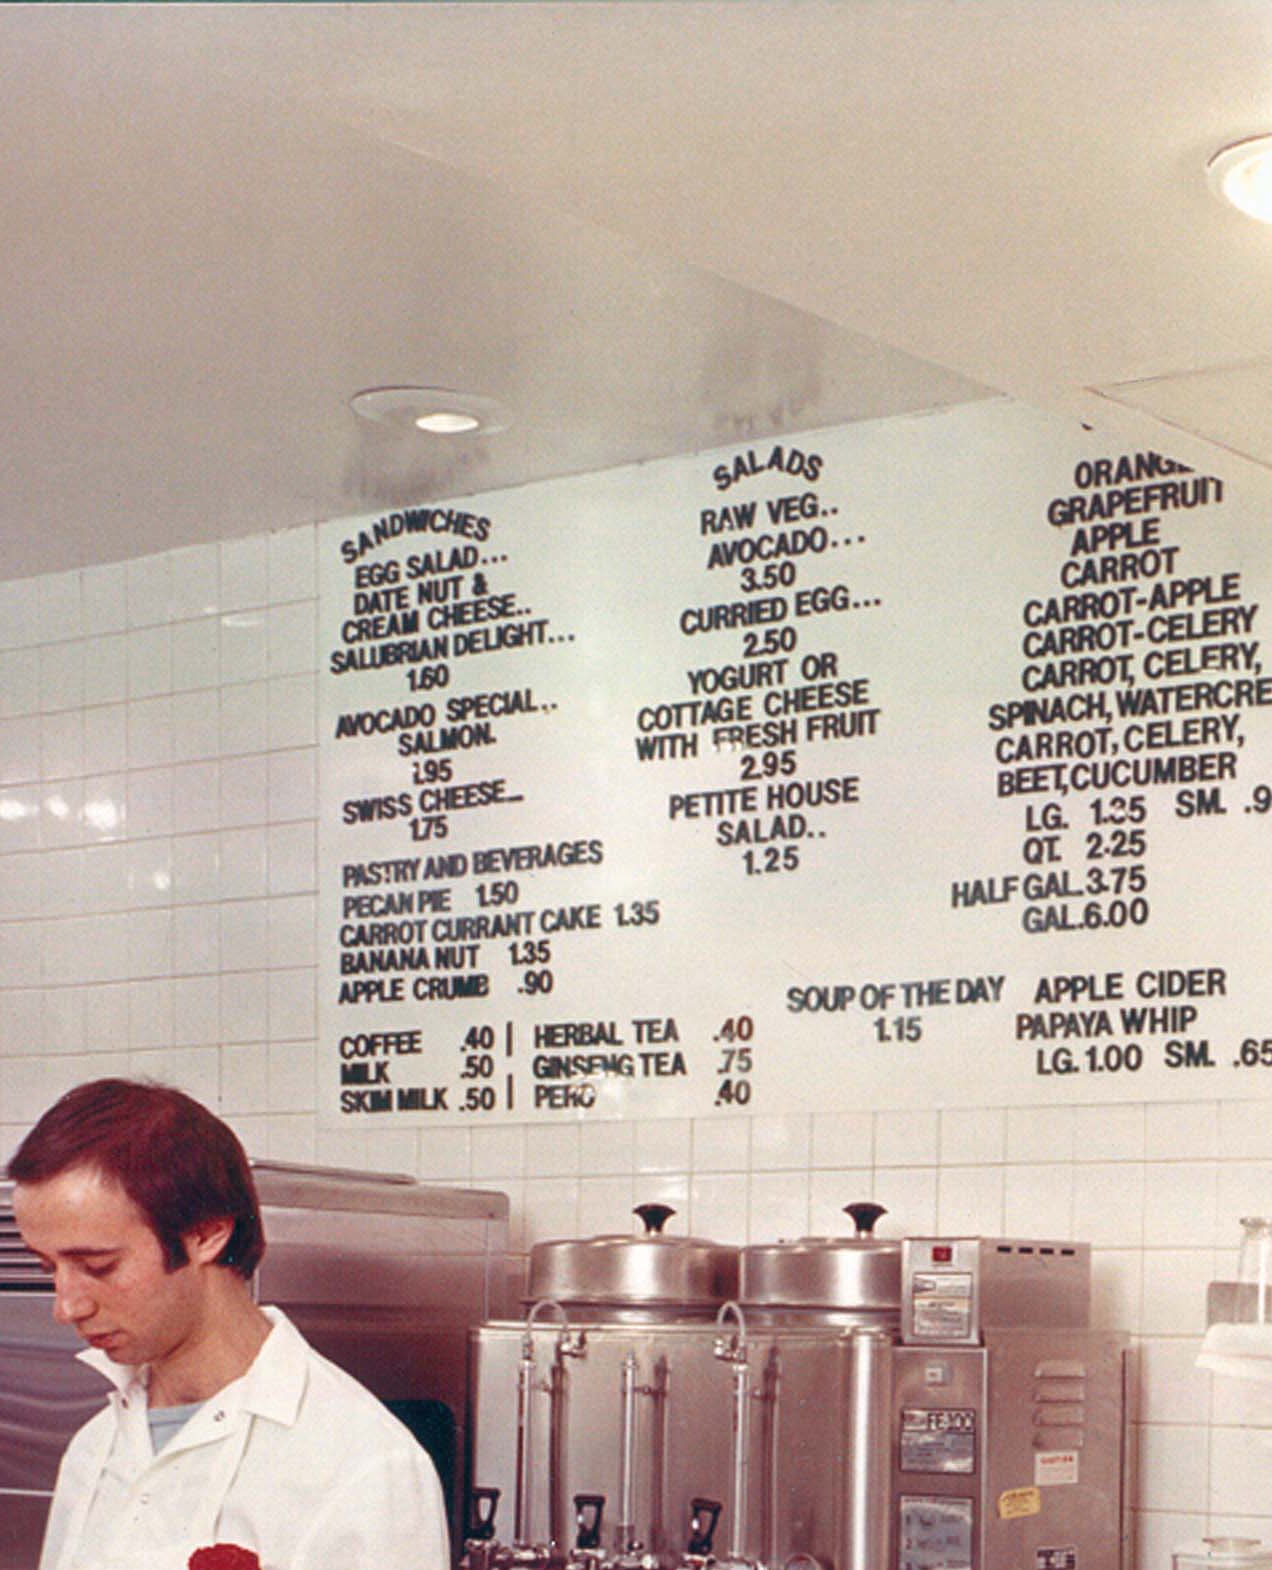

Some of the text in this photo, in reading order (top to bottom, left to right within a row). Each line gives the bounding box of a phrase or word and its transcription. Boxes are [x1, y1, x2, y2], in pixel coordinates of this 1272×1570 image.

[713, 445, 823, 491] SALADS
[340, 508, 492, 565] SANDWICHES
[700, 501, 757, 536] RAW
[1070, 517, 1161, 557] APPLE
[354, 559, 401, 590] EGG
[740, 560, 796, 593] 3.50
[1060, 546, 1180, 589] CARROT
[353, 572, 489, 616] DATE NUT &
[1023, 572, 1241, 628] CARROT-APPLE
[341, 609, 420, 645] CREAM
[680, 596, 788, 636] CURRIED
[1022, 601, 1260, 663] CARROT-CELERY
[330, 634, 449, 675] SALUBRIAN
[743, 626, 797, 658] 2.50
[406, 663, 450, 692] 1.60
[687, 652, 838, 695] YOGURT OR
[1021, 641, 1262, 693] CARROT, CELERY,
[335, 703, 436, 739] AVOCADO
[637, 678, 869, 733] COTTAGE CHEESE
[988, 691, 1113, 732] SPINACH,
[398, 721, 497, 757] SALMON.
[635, 708, 881, 761] WITH FRESH FRUIT
[995, 713, 1245, 765] CARROT, CELERY,
[740, 749, 797, 781] 2.95
[343, 792, 413, 825] SWISS
[669, 776, 859, 820] PETITE HOUSE
[1026, 802, 1069, 832] LG.
[1090, 795, 1147, 826] 1.35
[1175, 787, 1227, 818] SM.
[409, 814, 449, 842] 1.75
[343, 840, 603, 888] PASTRY AND BEVERAGES
[743, 845, 799, 875] 1.25
[1023, 829, 1146, 865] QT. 2.25
[343, 880, 519, 920] PECAN PIE 1.50
[951, 876, 1019, 908] HALF
[339, 901, 660, 948] CARROT CURRANT CAKE 1.35
[340, 939, 551, 976] BANANA NUT 1.35
[338, 969, 553, 1005] APPLE CRUMB .90
[787, 976, 1005, 1012] SOUP OF THE DAY
[1034, 968, 1226, 1004] APPLE CIDER
[534, 1015, 754, 1049] HERBAL TEA .40
[874, 1017, 922, 1042] 1.15
[1016, 1005, 1198, 1040] PAPAYA WHIP
[339, 1025, 495, 1060] COFFEE .40
[1085, 1043, 1143, 1073] 1.00
[1164, 1040, 1216, 1069] SM.
[340, 1054, 494, 1086] MILK .50
[532, 1047, 752, 1080] GINSENG TEA .75
[340, 1086, 496, 1114] SKIM MILK .50
[714, 1079, 751, 1106] .40
